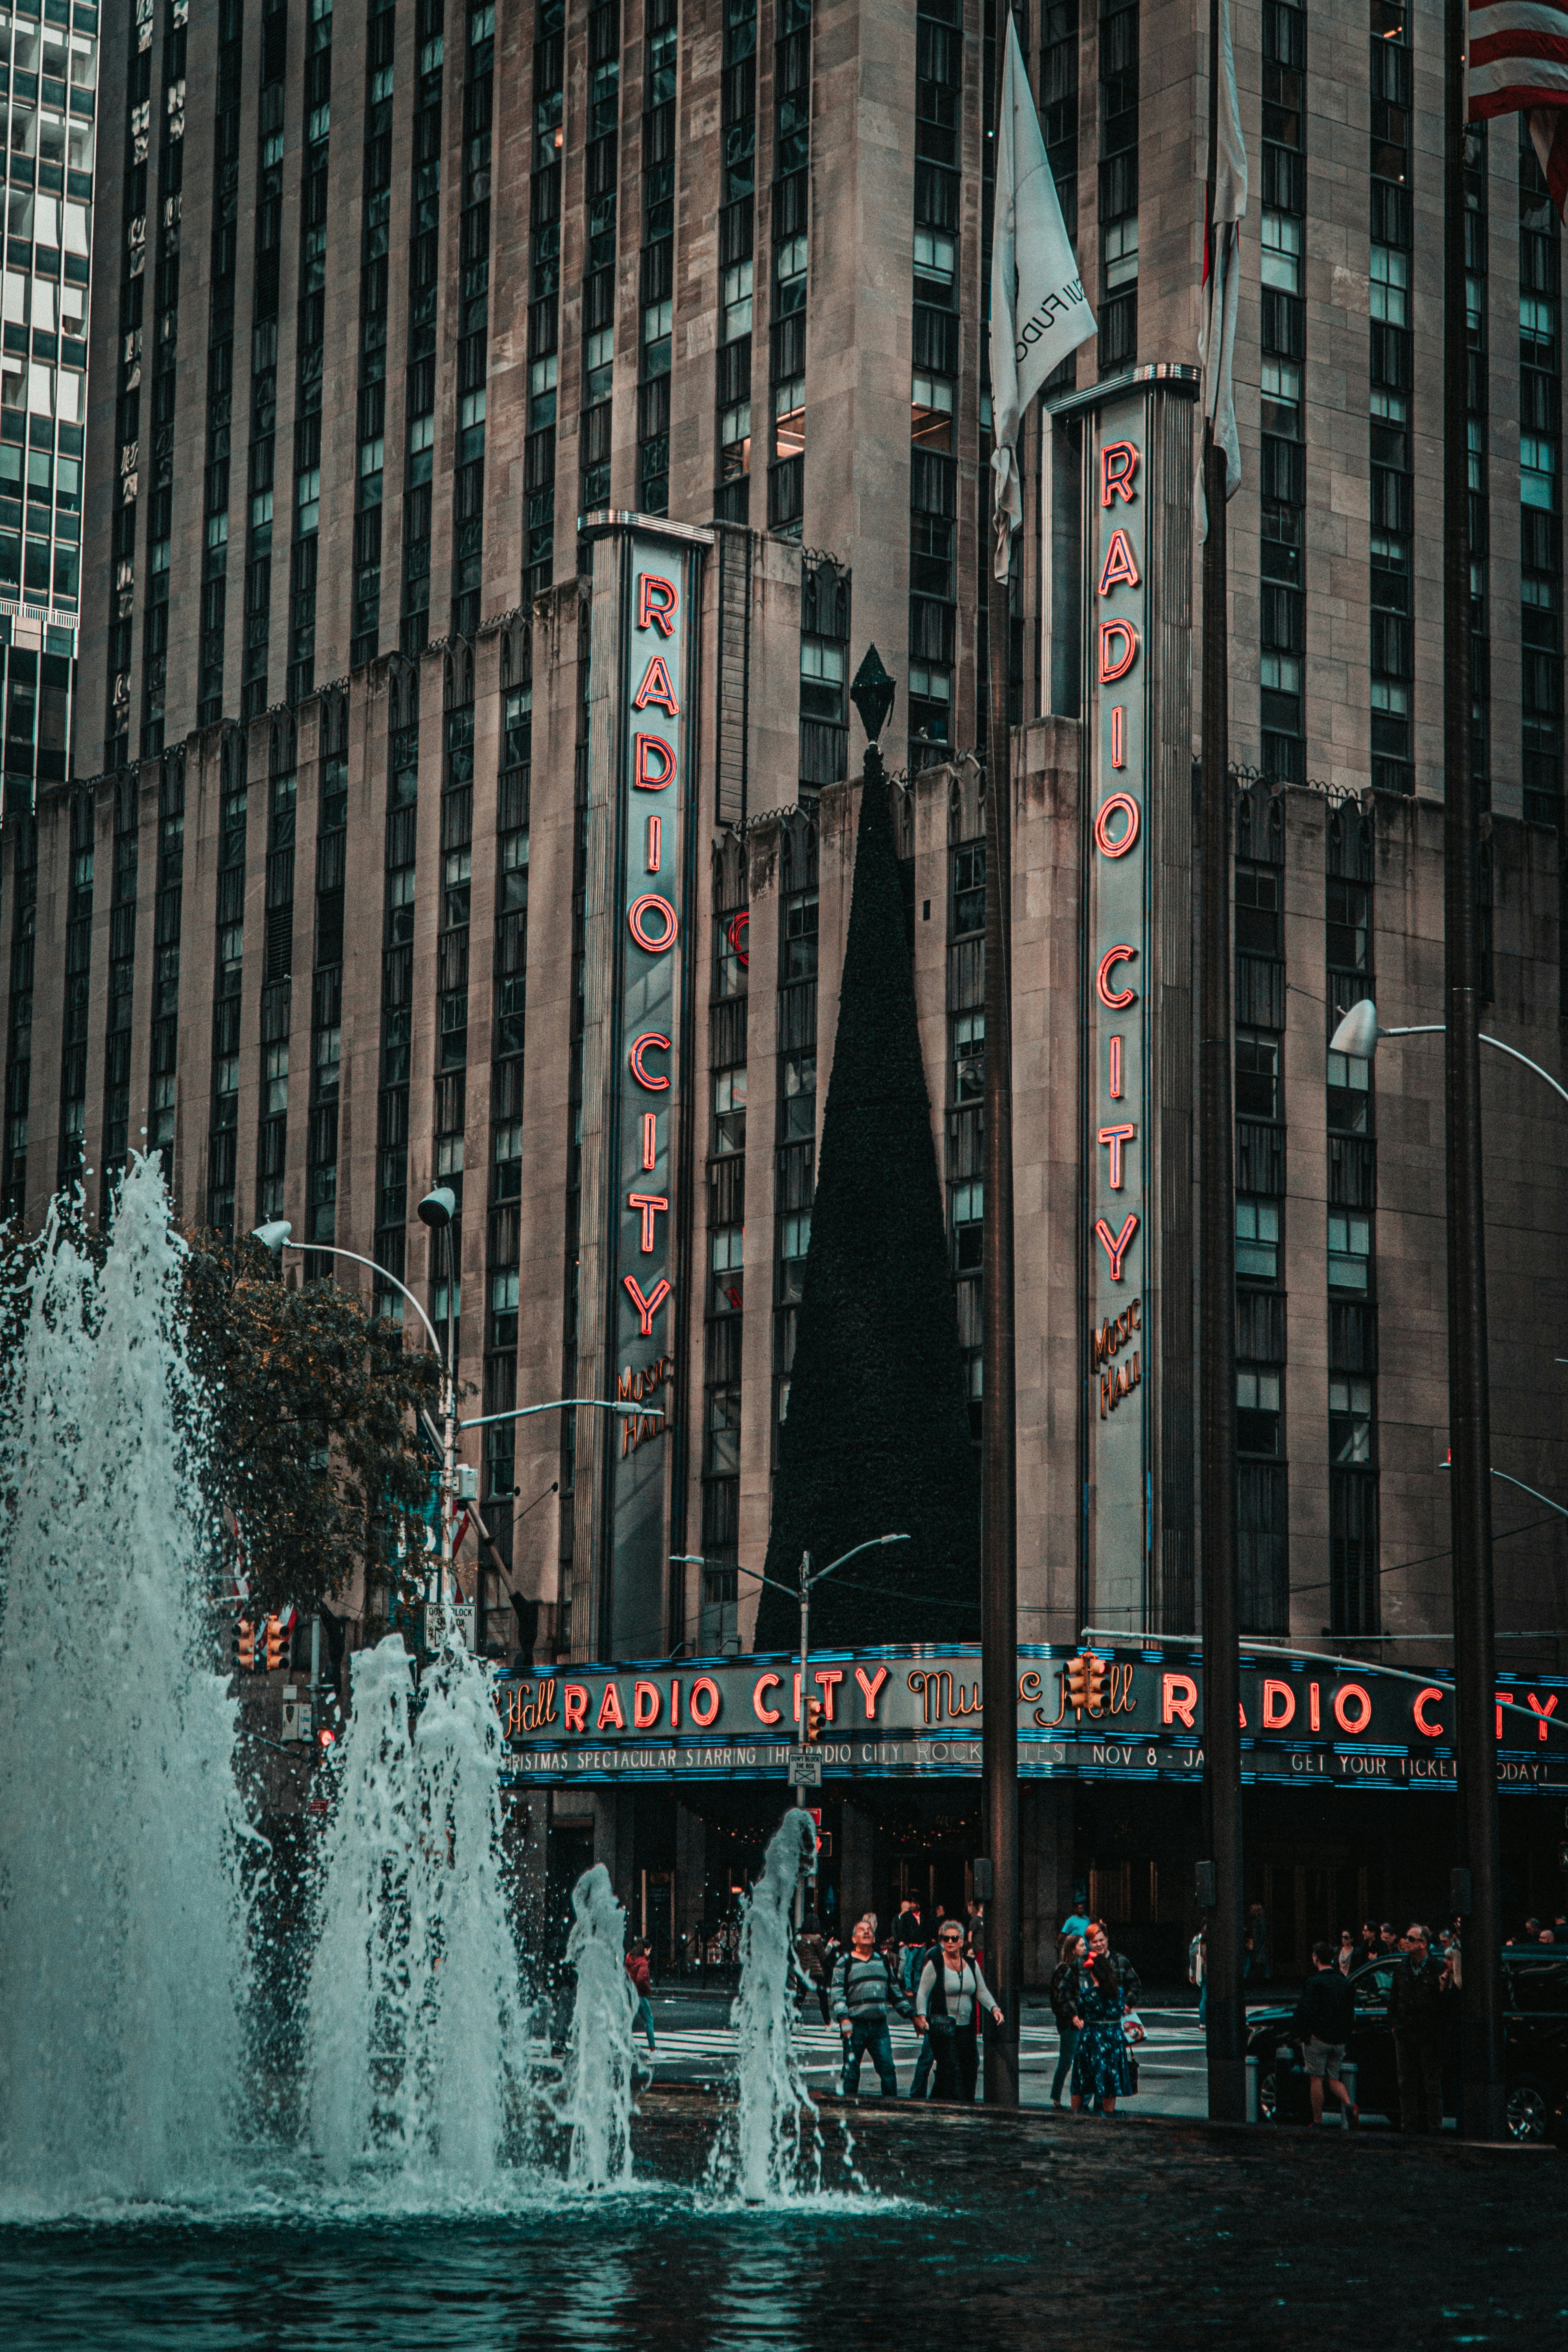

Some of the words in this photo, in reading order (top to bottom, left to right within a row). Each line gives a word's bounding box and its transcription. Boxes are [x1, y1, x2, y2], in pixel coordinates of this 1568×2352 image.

[1094, 440, 1139, 858] RADIO
[628, 572, 680, 952] RADIO
[1095, 944, 1137, 1281] CITY
[624, 1032, 671, 1335] CITY
[1093, 1299, 1141, 1372] MUSIC
[617, 1356, 672, 1402] MUSIC
[1101, 1352, 1141, 1417] HALL
[623, 1405, 672, 1456] HALL
[504, 1678, 556, 1738] Hall
[564, 1676, 719, 1732] RADIO
[753, 1666, 887, 1724] CITY
[907, 1670, 1042, 1723] Muc
[1163, 1673, 1372, 1733] RDIO
[1413, 1687, 1558, 1741] CTY
[504, 1752, 568, 1770] HRISTMAS
[578, 1750, 676, 1769] SPECTACULAR
[686, 1747, 756, 1766] STARRING
[862, 1743, 900, 1762] CITY
[918, 1742, 1064, 1763] ROCKTES
[1093, 1745, 1132, 1765] NOV
[1147, 1747, 1157, 1766] 8
[1184, 1749, 1204, 1767] JA
[1292, 1753, 1324, 1772] GET
[1340, 1755, 1386, 1774] YOUR
[1497, 1762, 1547, 1780] ODAY!
